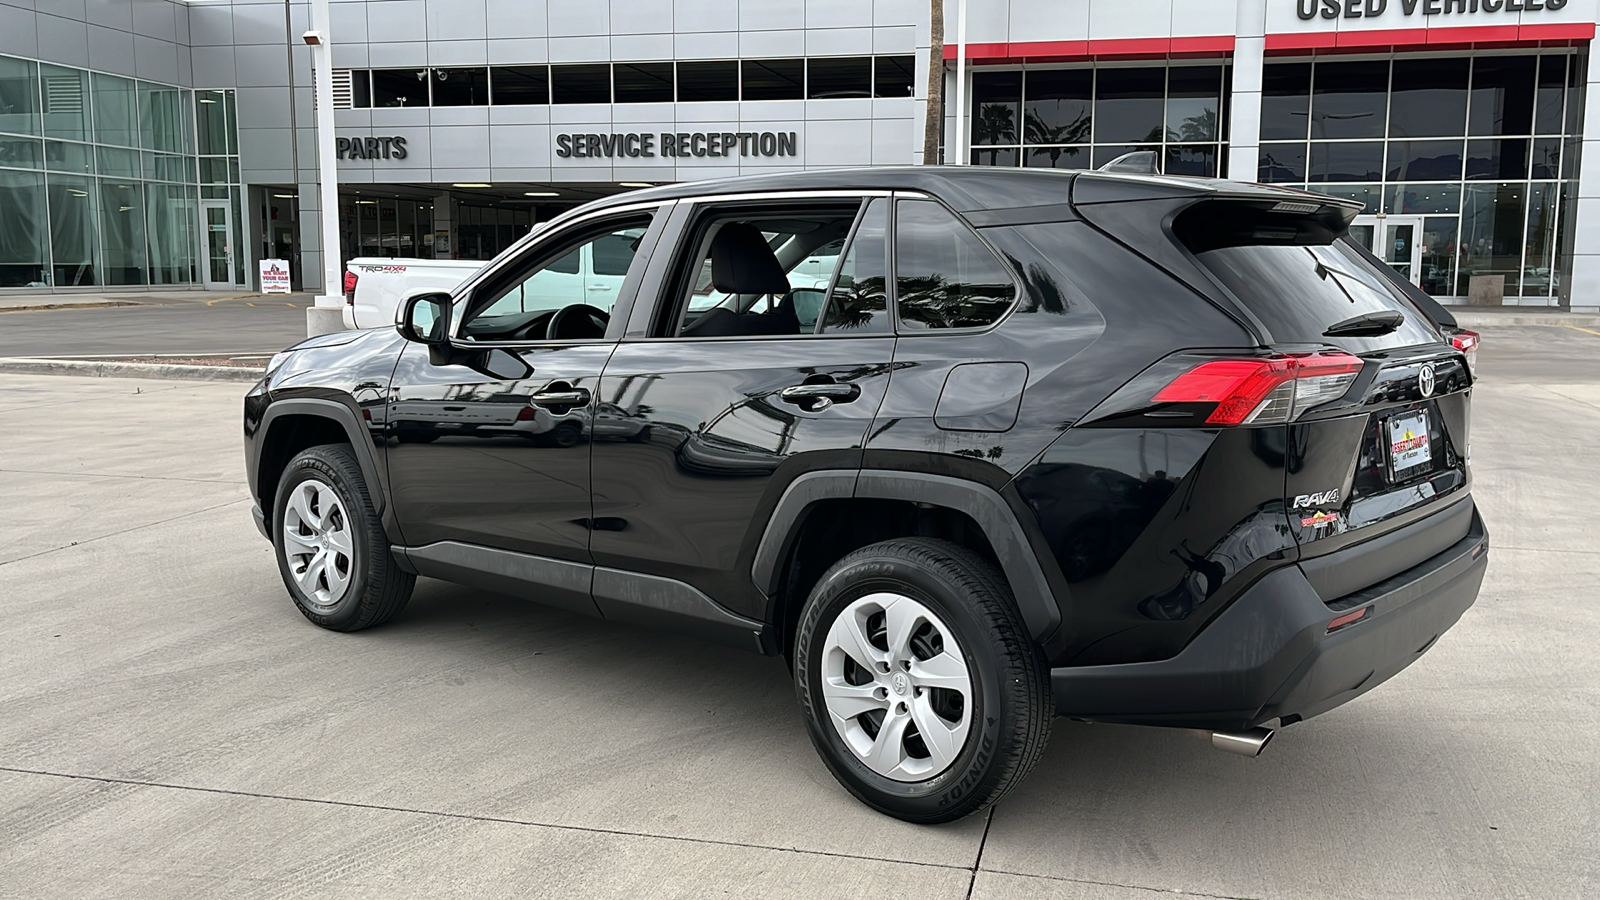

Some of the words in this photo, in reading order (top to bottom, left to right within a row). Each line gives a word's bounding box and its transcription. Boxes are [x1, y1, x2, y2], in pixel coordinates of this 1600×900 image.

[1296, 0, 1388, 20] USED
[335, 136, 407, 160] PARTS
[556, 133, 655, 158] SERVICE
[660, 132, 797, 158] RECEPTION
[1293, 488, 1339, 508] RAV4
[939, 732, 994, 806] DUNLOP
